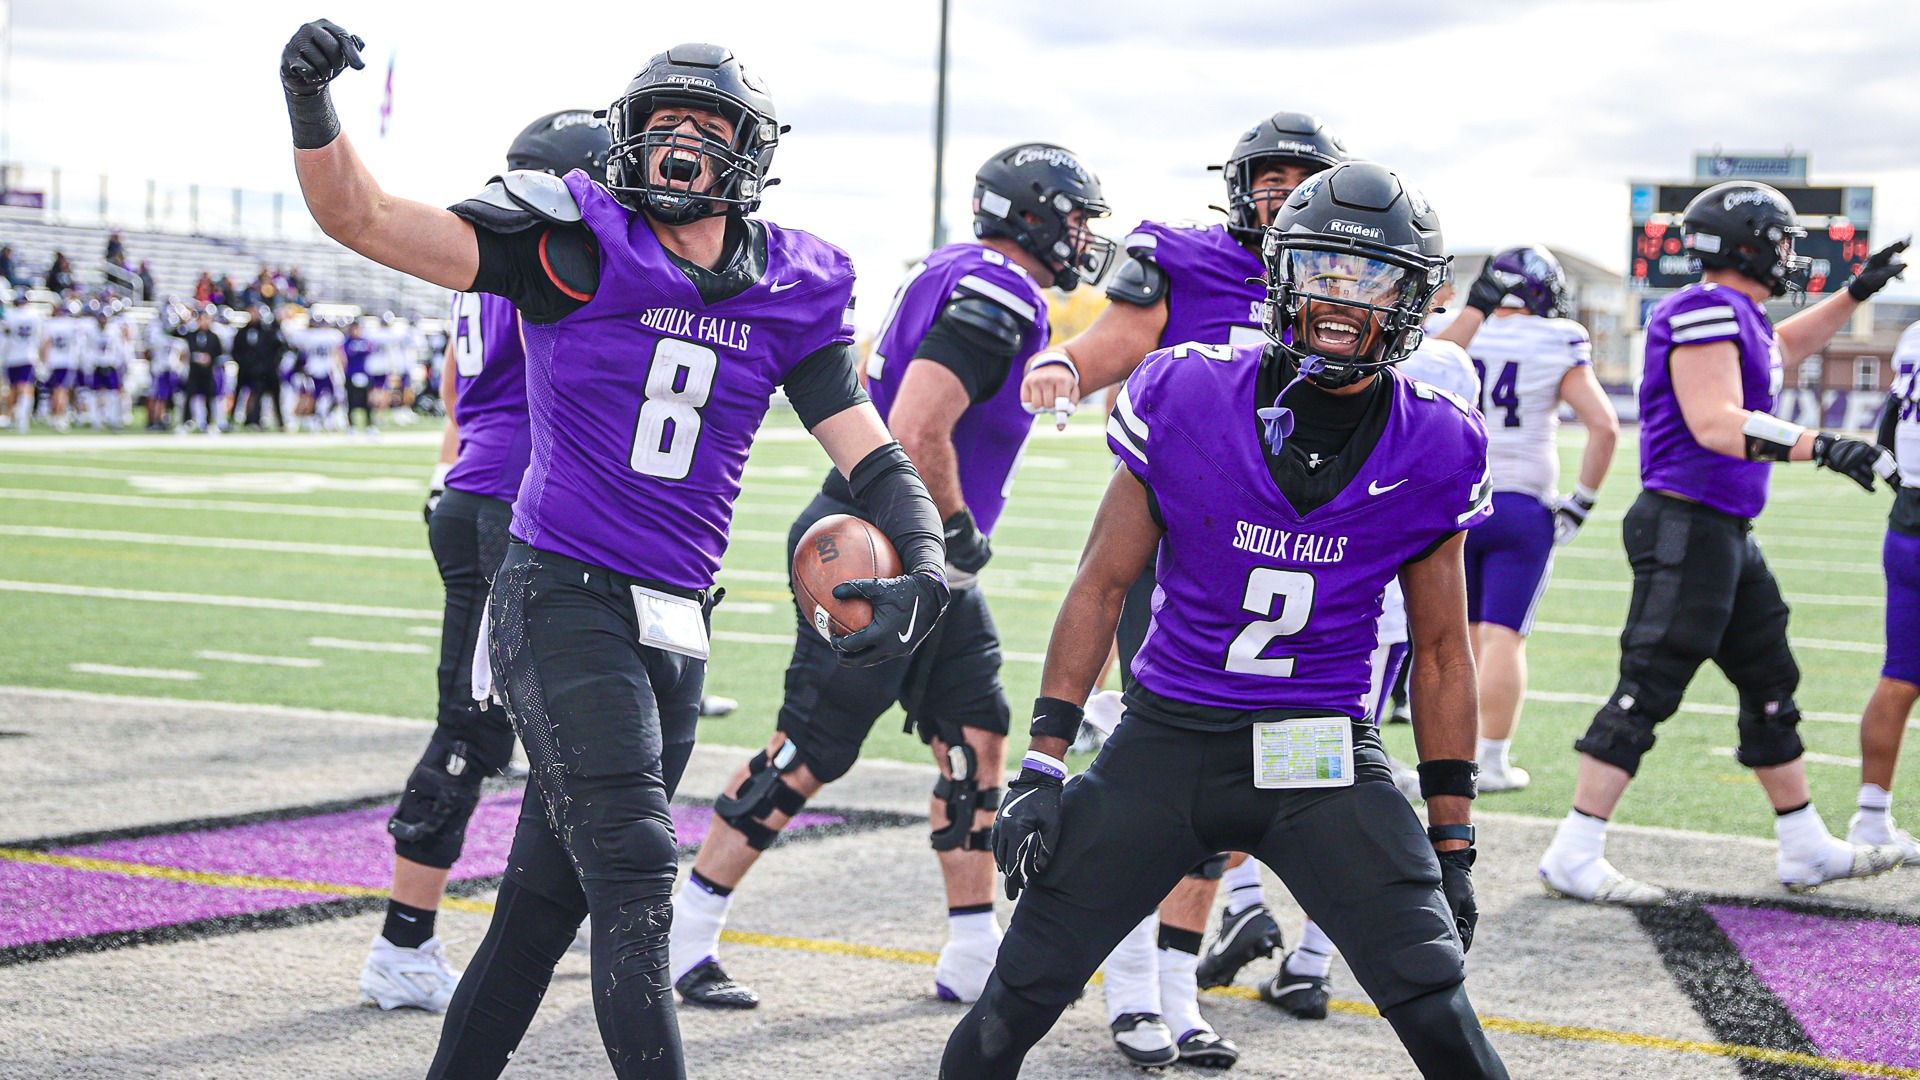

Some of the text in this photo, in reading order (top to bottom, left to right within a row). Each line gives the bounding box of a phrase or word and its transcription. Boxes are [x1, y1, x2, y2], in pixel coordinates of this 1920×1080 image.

[1331, 221, 1380, 239] Riddell
[640, 308, 751, 351] SIOUX FALLS
[629, 337, 719, 481] 8
[1232, 520, 1348, 563] SIOUX FALLS
[1224, 566, 1316, 678] 2
